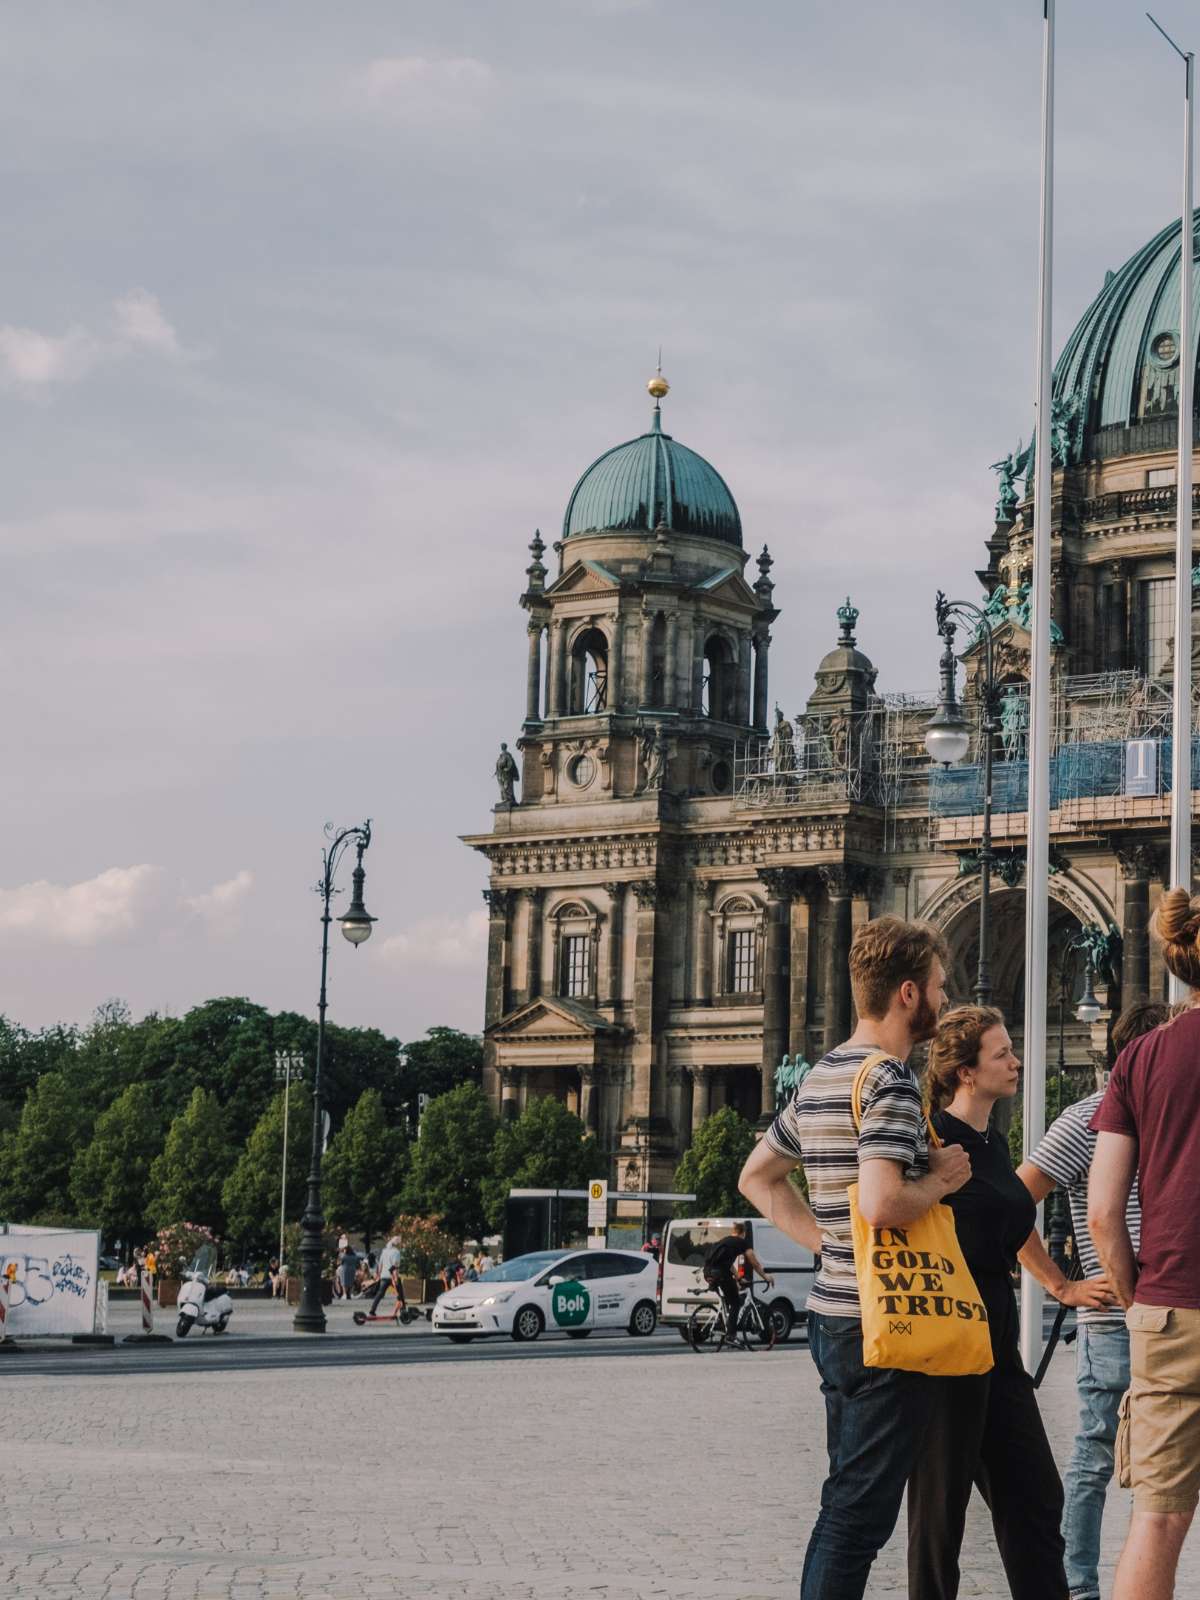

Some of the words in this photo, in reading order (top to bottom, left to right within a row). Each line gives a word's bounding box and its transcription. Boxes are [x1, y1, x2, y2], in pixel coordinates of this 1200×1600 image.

[873, 1227, 909, 1247] IN
[872, 1250, 955, 1275] GOLD
[876, 1272, 944, 1292] WE
[558, 1294, 585, 1313] Bolt
[878, 1295, 988, 1322] TRUST
